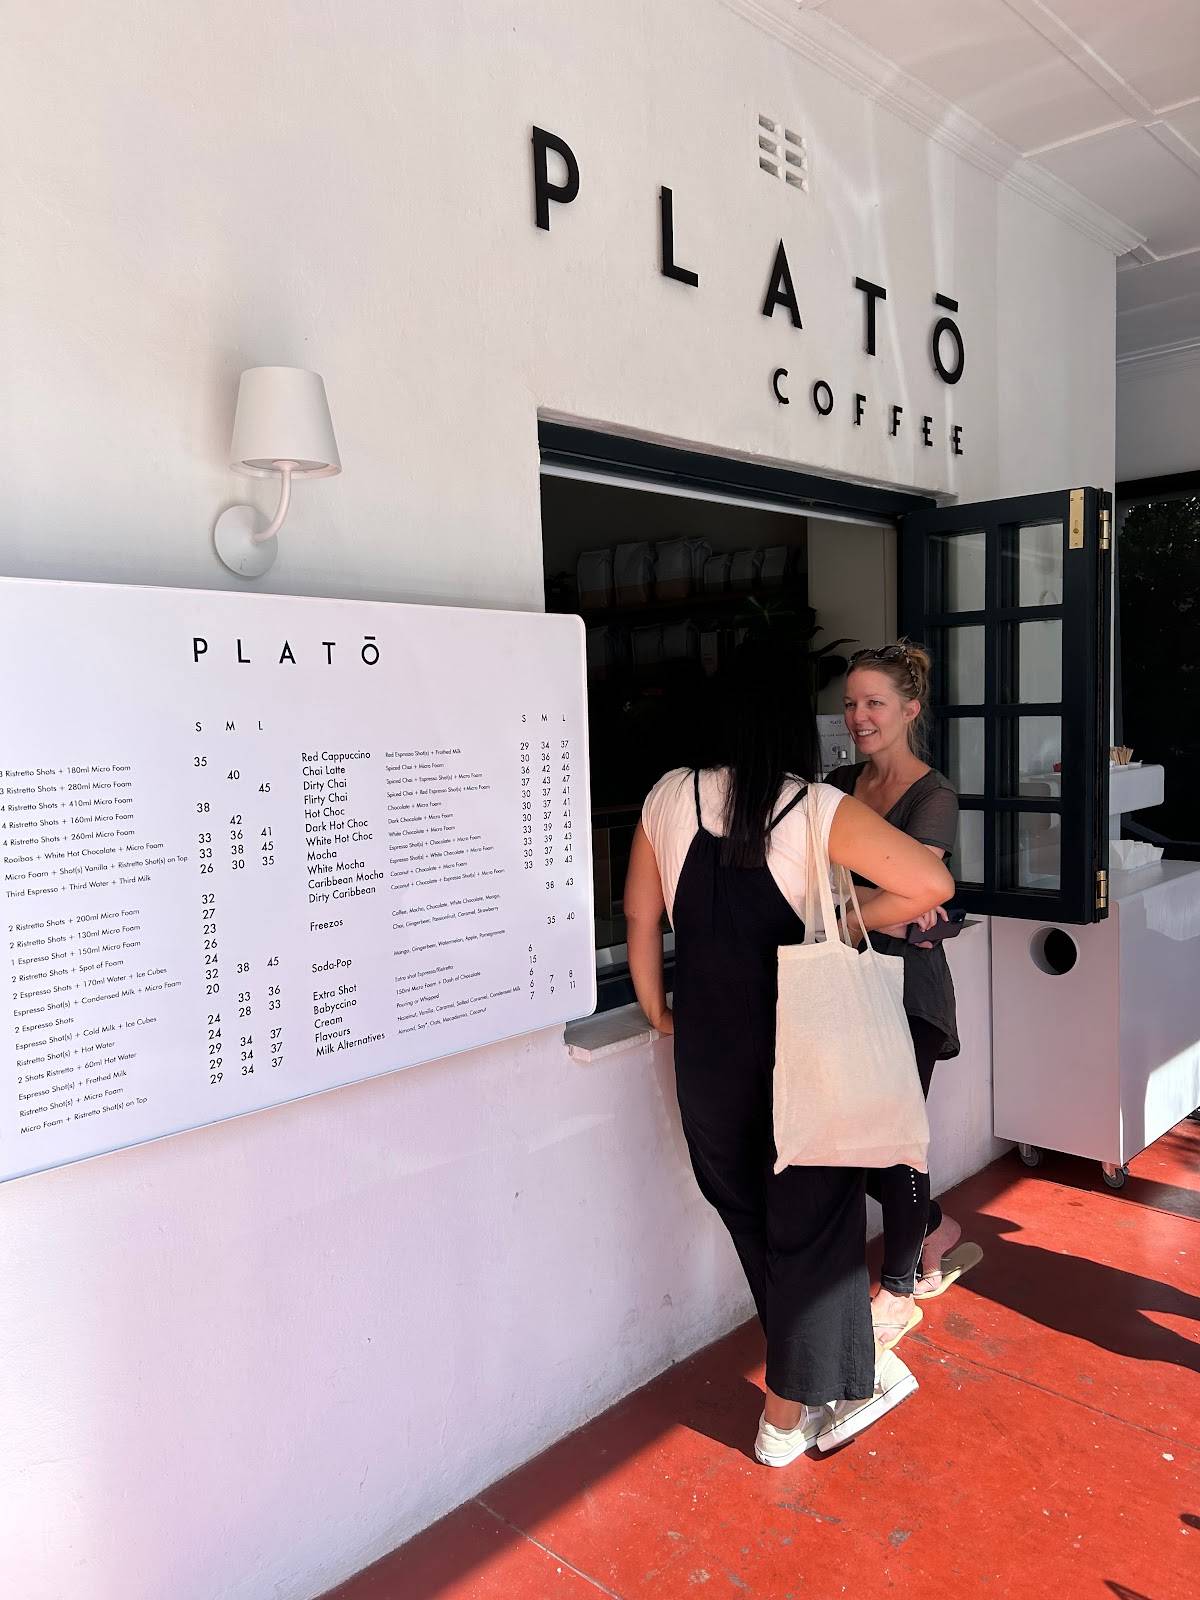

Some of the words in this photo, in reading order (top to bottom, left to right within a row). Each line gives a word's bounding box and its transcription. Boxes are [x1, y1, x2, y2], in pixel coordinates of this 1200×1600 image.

[532, 125, 965, 384] PLATŌ
[772, 368, 964, 455] COFFEE
[193, 636, 381, 666] PLATŌ
[521, 714, 527, 723] S
[541, 713, 548, 722] M
[195, 721, 202, 732] S
[225, 721, 236, 731] M
[258, 720, 263, 731] L
[520, 742, 530, 751] 29
[540, 740, 550, 750] 34
[560, 740, 569, 749] 37
[194, 756, 207, 767] 35
[301, 751, 319, 762] Red
[321, 750, 371, 764] Cappuccino
[520, 753, 530, 763] 30
[540, 752, 551, 762] 36
[561, 751, 570, 760] 40
[227, 769, 240, 780] 40
[302, 765, 323, 777] Chai
[325, 765, 346, 775] Latte
[521, 765, 531, 775] 36
[541, 764, 551, 773] 42
[561, 763, 570, 771] 46
[258, 782, 271, 793] 45
[303, 780, 325, 793] Dirty
[327, 778, 347, 790] Chai
[521, 777, 531, 787] 37
[542, 776, 551, 785] 43
[562, 774, 571, 783] 47
[304, 794, 326, 807] Flirty
[328, 792, 348, 803] Chai
[196, 802, 210, 813] 38
[304, 809, 321, 819] Hot
[322, 806, 345, 817] Choc
[229, 814, 242, 825] 42
[305, 820, 327, 833] Dark
[329, 820, 345, 831] Hot
[346, 818, 368, 829] Choc
[198, 832, 212, 844] 33
[230, 829, 244, 841] 36
[260, 826, 272, 837] 41
[305, 836, 332, 847] White
[334, 834, 350, 844] Hot
[351, 831, 373, 842] Choc
[199, 847, 213, 859] 33
[231, 844, 244, 855] 38
[261, 840, 274, 852] 45
[307, 848, 337, 861] Mocha
[200, 862, 214, 875] 26
[231, 859, 245, 870] 30
[262, 855, 275, 866] 35
[306, 863, 333, 876] White
[335, 859, 365, 872] Mocha
[524, 860, 533, 870] 33
[544, 857, 554, 867] 39
[564, 854, 573, 863] 43
[308, 875, 353, 889] Caribbean
[356, 869, 384, 882] Mocha
[545, 880, 555, 890] 38
[565, 877, 574, 886] 43
[308, 892, 330, 904] Dirty
[332, 885, 376, 900] Caribbean
[202, 908, 216, 920] 27
[547, 915, 556, 925] 35
[566, 911, 575, 920] 40
[203, 923, 217, 935] 23
[310, 919, 344, 932] Freezos
[203, 938, 218, 951] 26
[312, 958, 352, 973] Soda-Pop
[529, 954, 537, 964] 15
[205, 968, 219, 980] 32
[236, 962, 250, 974] 38
[267, 956, 279, 967] 45
[529, 979, 535, 988] 6
[549, 974, 554, 983] 7
[568, 969, 573, 978] 8
[313, 990, 336, 1001] Extra
[338, 984, 357, 996] Shot
[313, 998, 357, 1015] Babyccino
[314, 1016, 343, 1029] Cream
[208, 1042, 222, 1055] 29
[240, 1035, 253, 1047] 34
[270, 1027, 282, 1039] 37
[315, 1028, 351, 1043] Flavours
[316, 1043, 335, 1057] Milk
[336, 1033, 385, 1052] Alternatives
